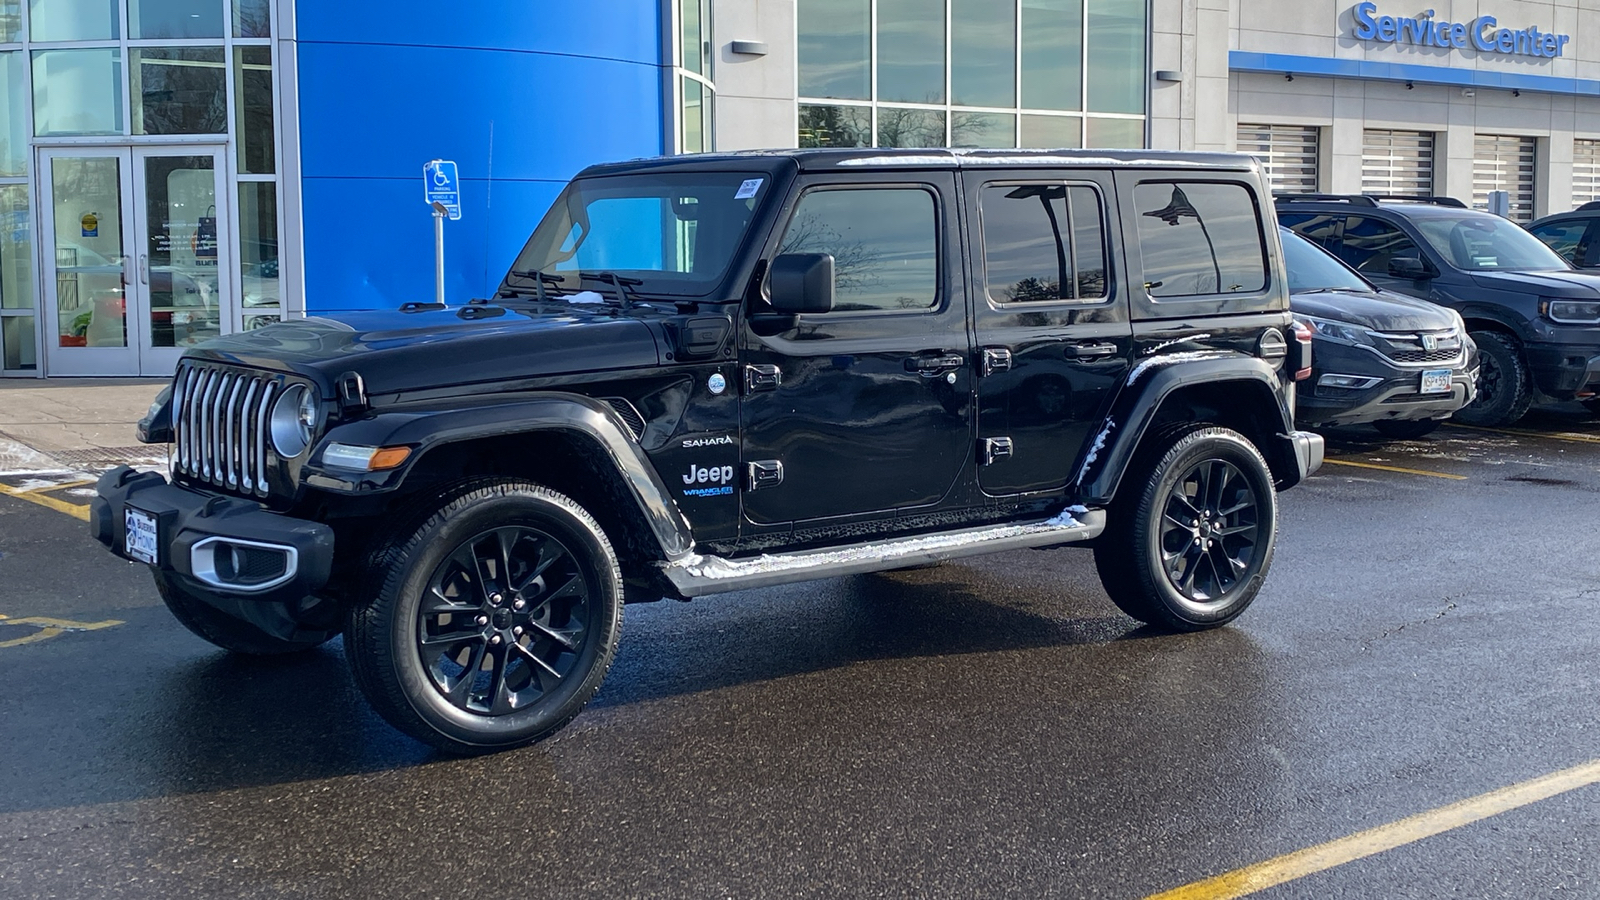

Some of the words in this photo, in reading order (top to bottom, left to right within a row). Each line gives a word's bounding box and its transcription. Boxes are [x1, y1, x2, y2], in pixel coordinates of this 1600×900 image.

[1354, 1, 1467, 48] Service
[1471, 15, 1570, 58] Center
[682, 435, 733, 448] SAHARA
[682, 464, 733, 485] Jeep
[683, 486, 733, 496] WRANGLER
[136, 518, 157, 535] BUERKL
